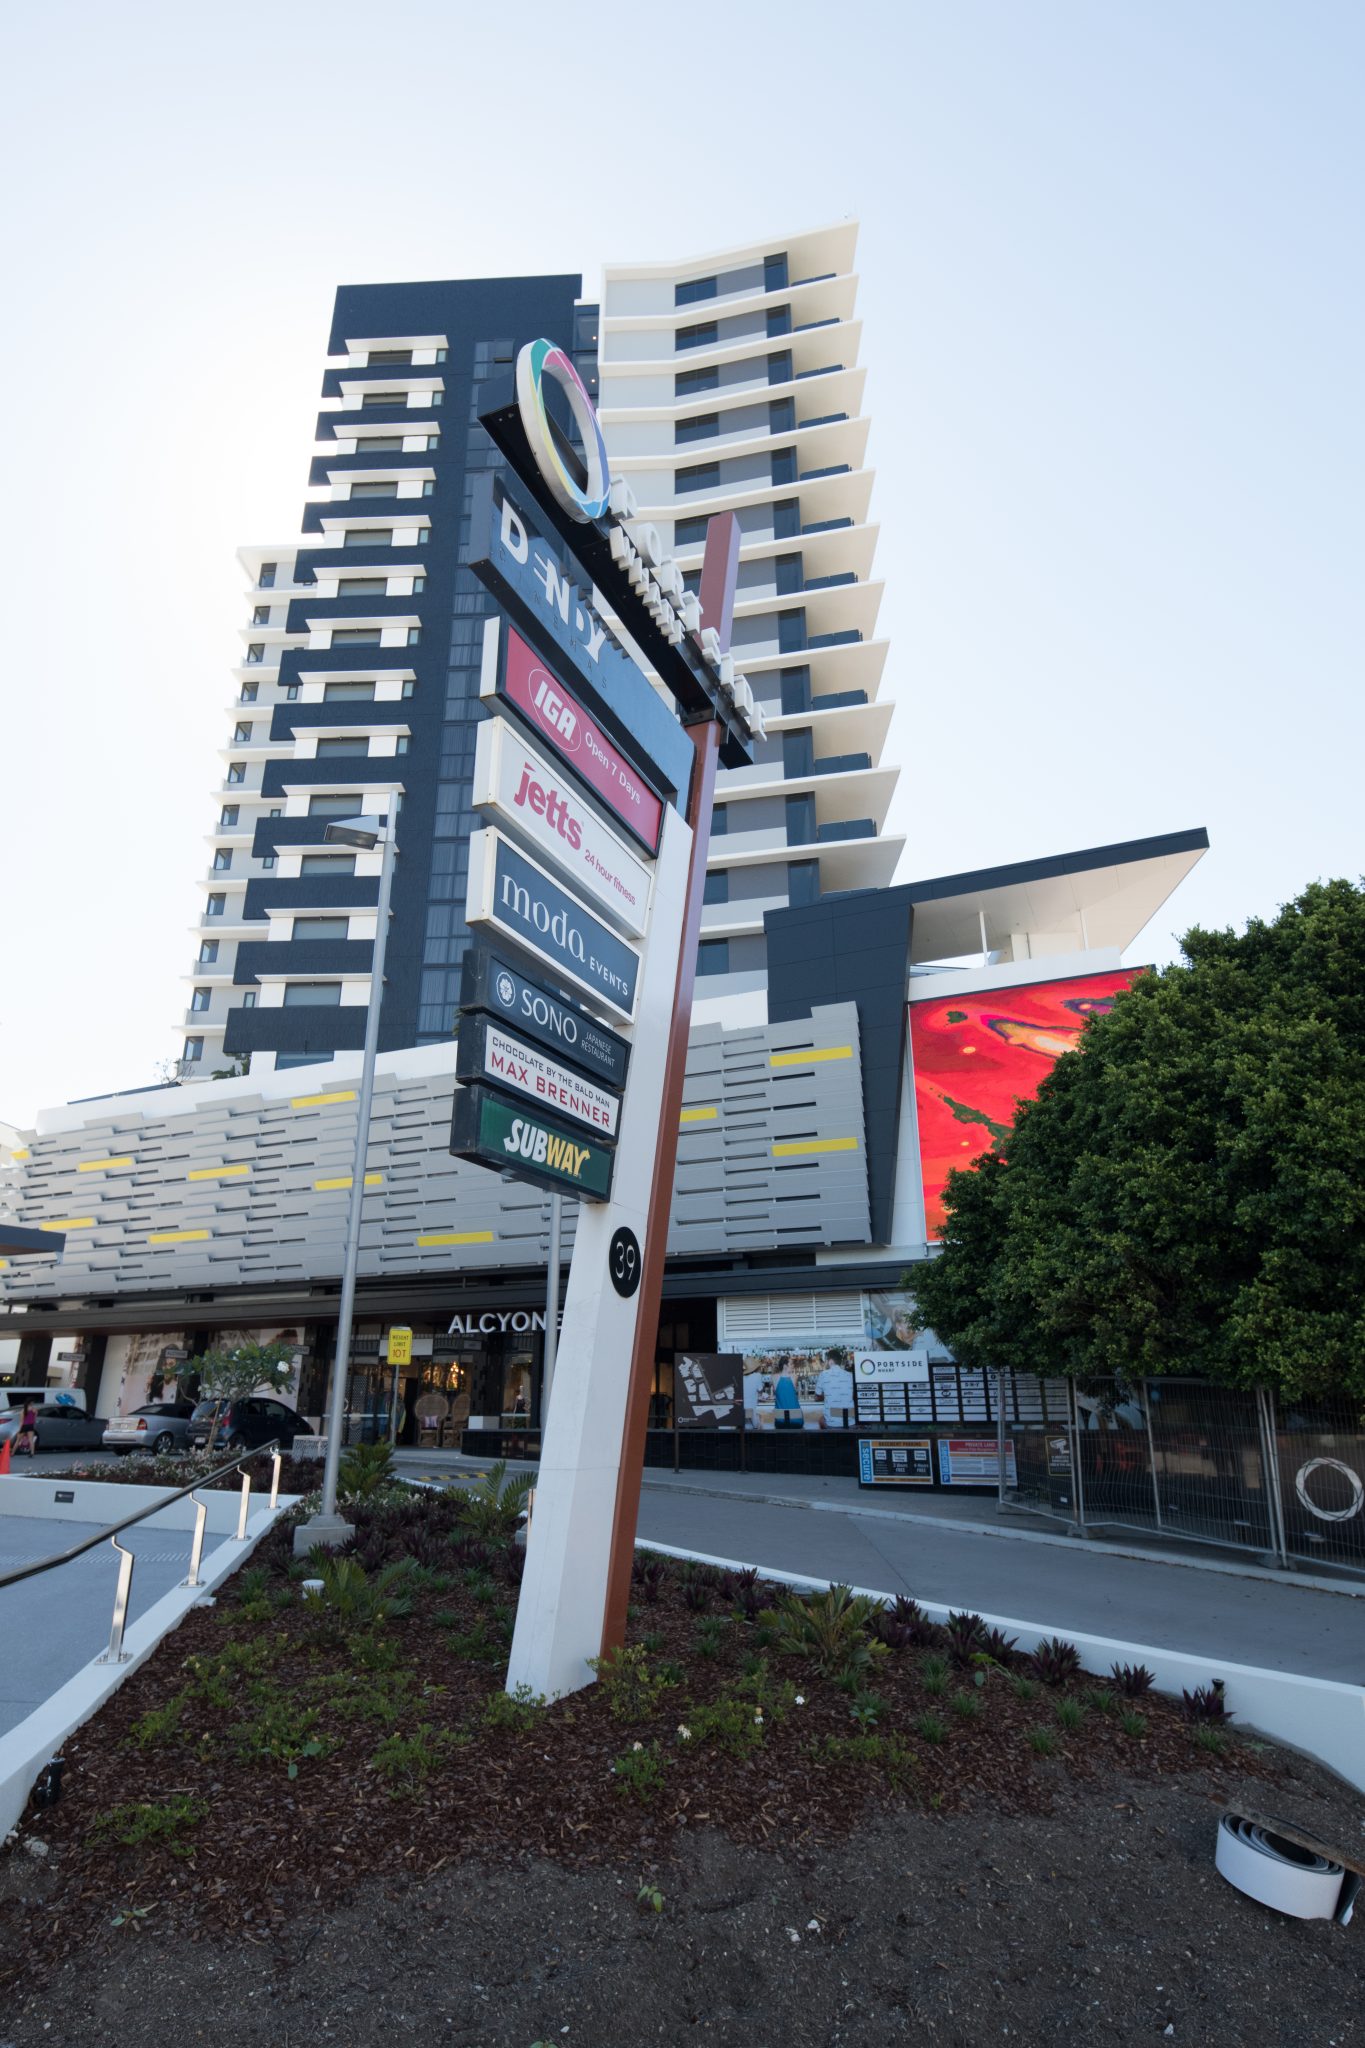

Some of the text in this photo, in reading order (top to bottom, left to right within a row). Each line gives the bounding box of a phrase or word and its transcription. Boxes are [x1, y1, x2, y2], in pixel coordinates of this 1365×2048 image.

[501, 497, 607, 664] DENDY
[534, 679, 577, 742] IGA
[584, 731, 642, 804] Open 7 Days
[513, 761, 583, 850] jetts
[585, 849, 636, 905] 24 hour fitness
[501, 874, 628, 997] moda EVENTS
[521, 988, 578, 1044] SONO
[585, 1032, 611, 1054] JAPANESE
[492, 1036, 610, 1108] CHOCOLATE BY THE BALD MAN
[581, 1039, 616, 1067] RESTAURANT
[491, 1051, 610, 1128] MAX BRENNER
[503, 1118, 591, 1177] SUBWAY
[615, 1241, 636, 1281] 39
[877, 1360, 923, 1368] PORTSIDE
[862, 1448, 871, 1480] secure
